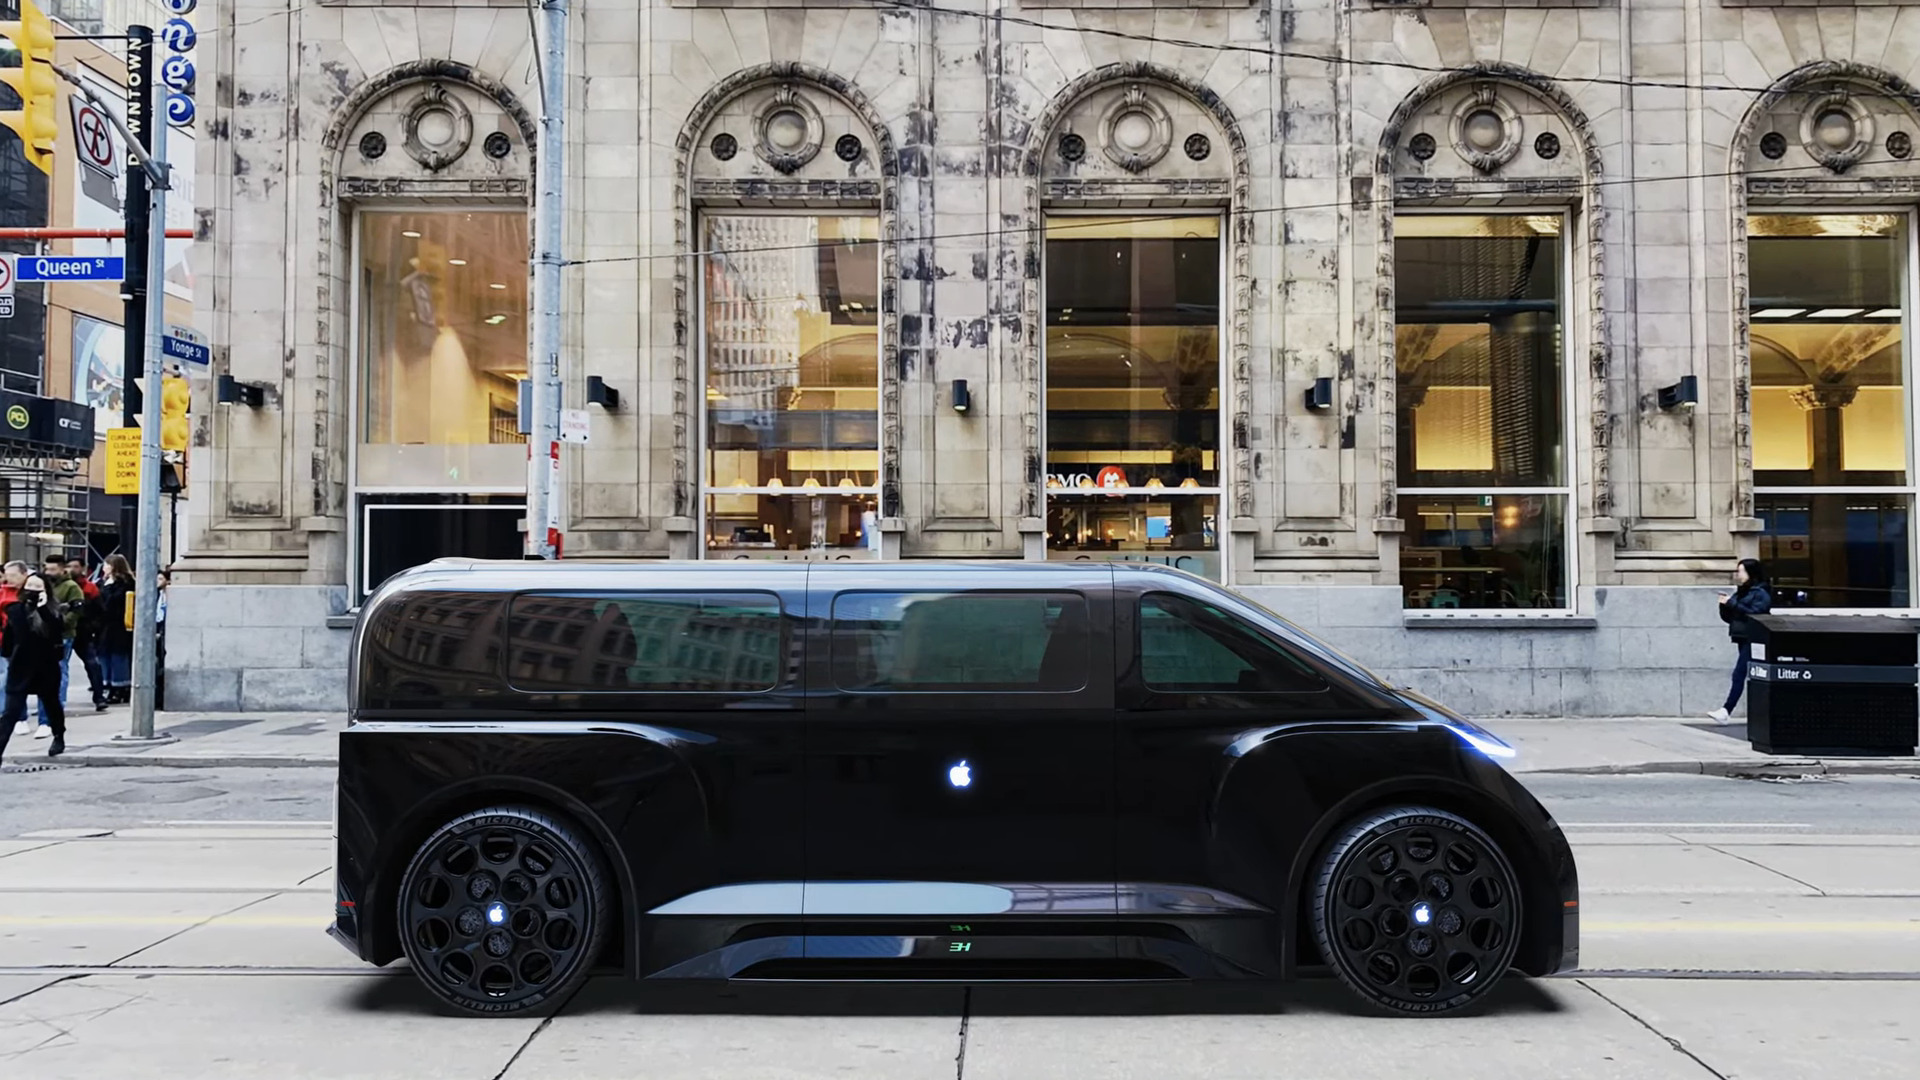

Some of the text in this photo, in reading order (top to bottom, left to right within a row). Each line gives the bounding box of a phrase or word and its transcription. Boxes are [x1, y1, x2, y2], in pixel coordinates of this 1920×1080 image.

[128, 38, 141, 166] DWNTOWN
[36, 258, 105, 277] Queen St
[171, 339, 202, 358] Yonge St
[117, 461, 136, 469] SLOW
[1778, 668, 1799, 679] Litter
[475, 816, 541, 832] MICHELIN
[1398, 816, 1464, 832] MICHELIN
